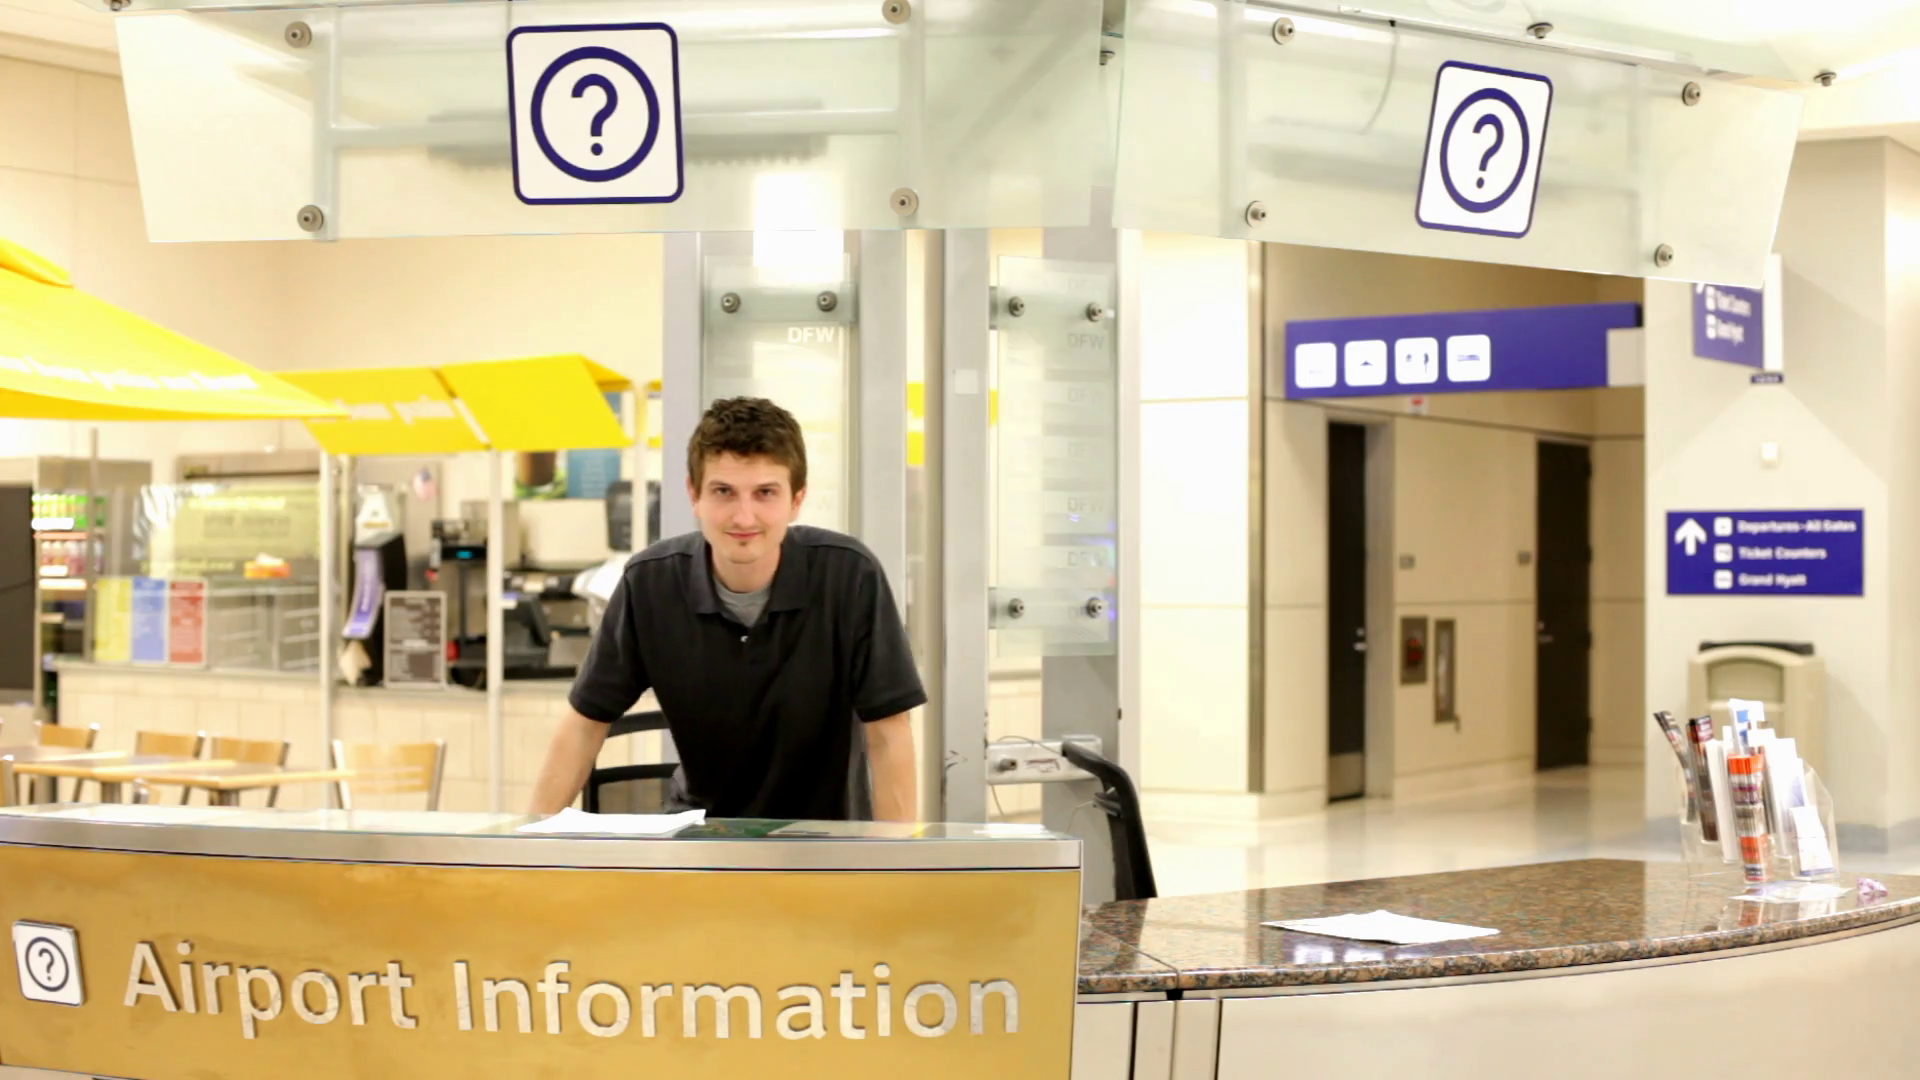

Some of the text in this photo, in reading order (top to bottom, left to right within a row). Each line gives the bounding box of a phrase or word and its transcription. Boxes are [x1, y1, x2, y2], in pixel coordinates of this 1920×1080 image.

[787, 326, 835, 343] DFW
[123, 940, 1020, 1040] Airport Information
